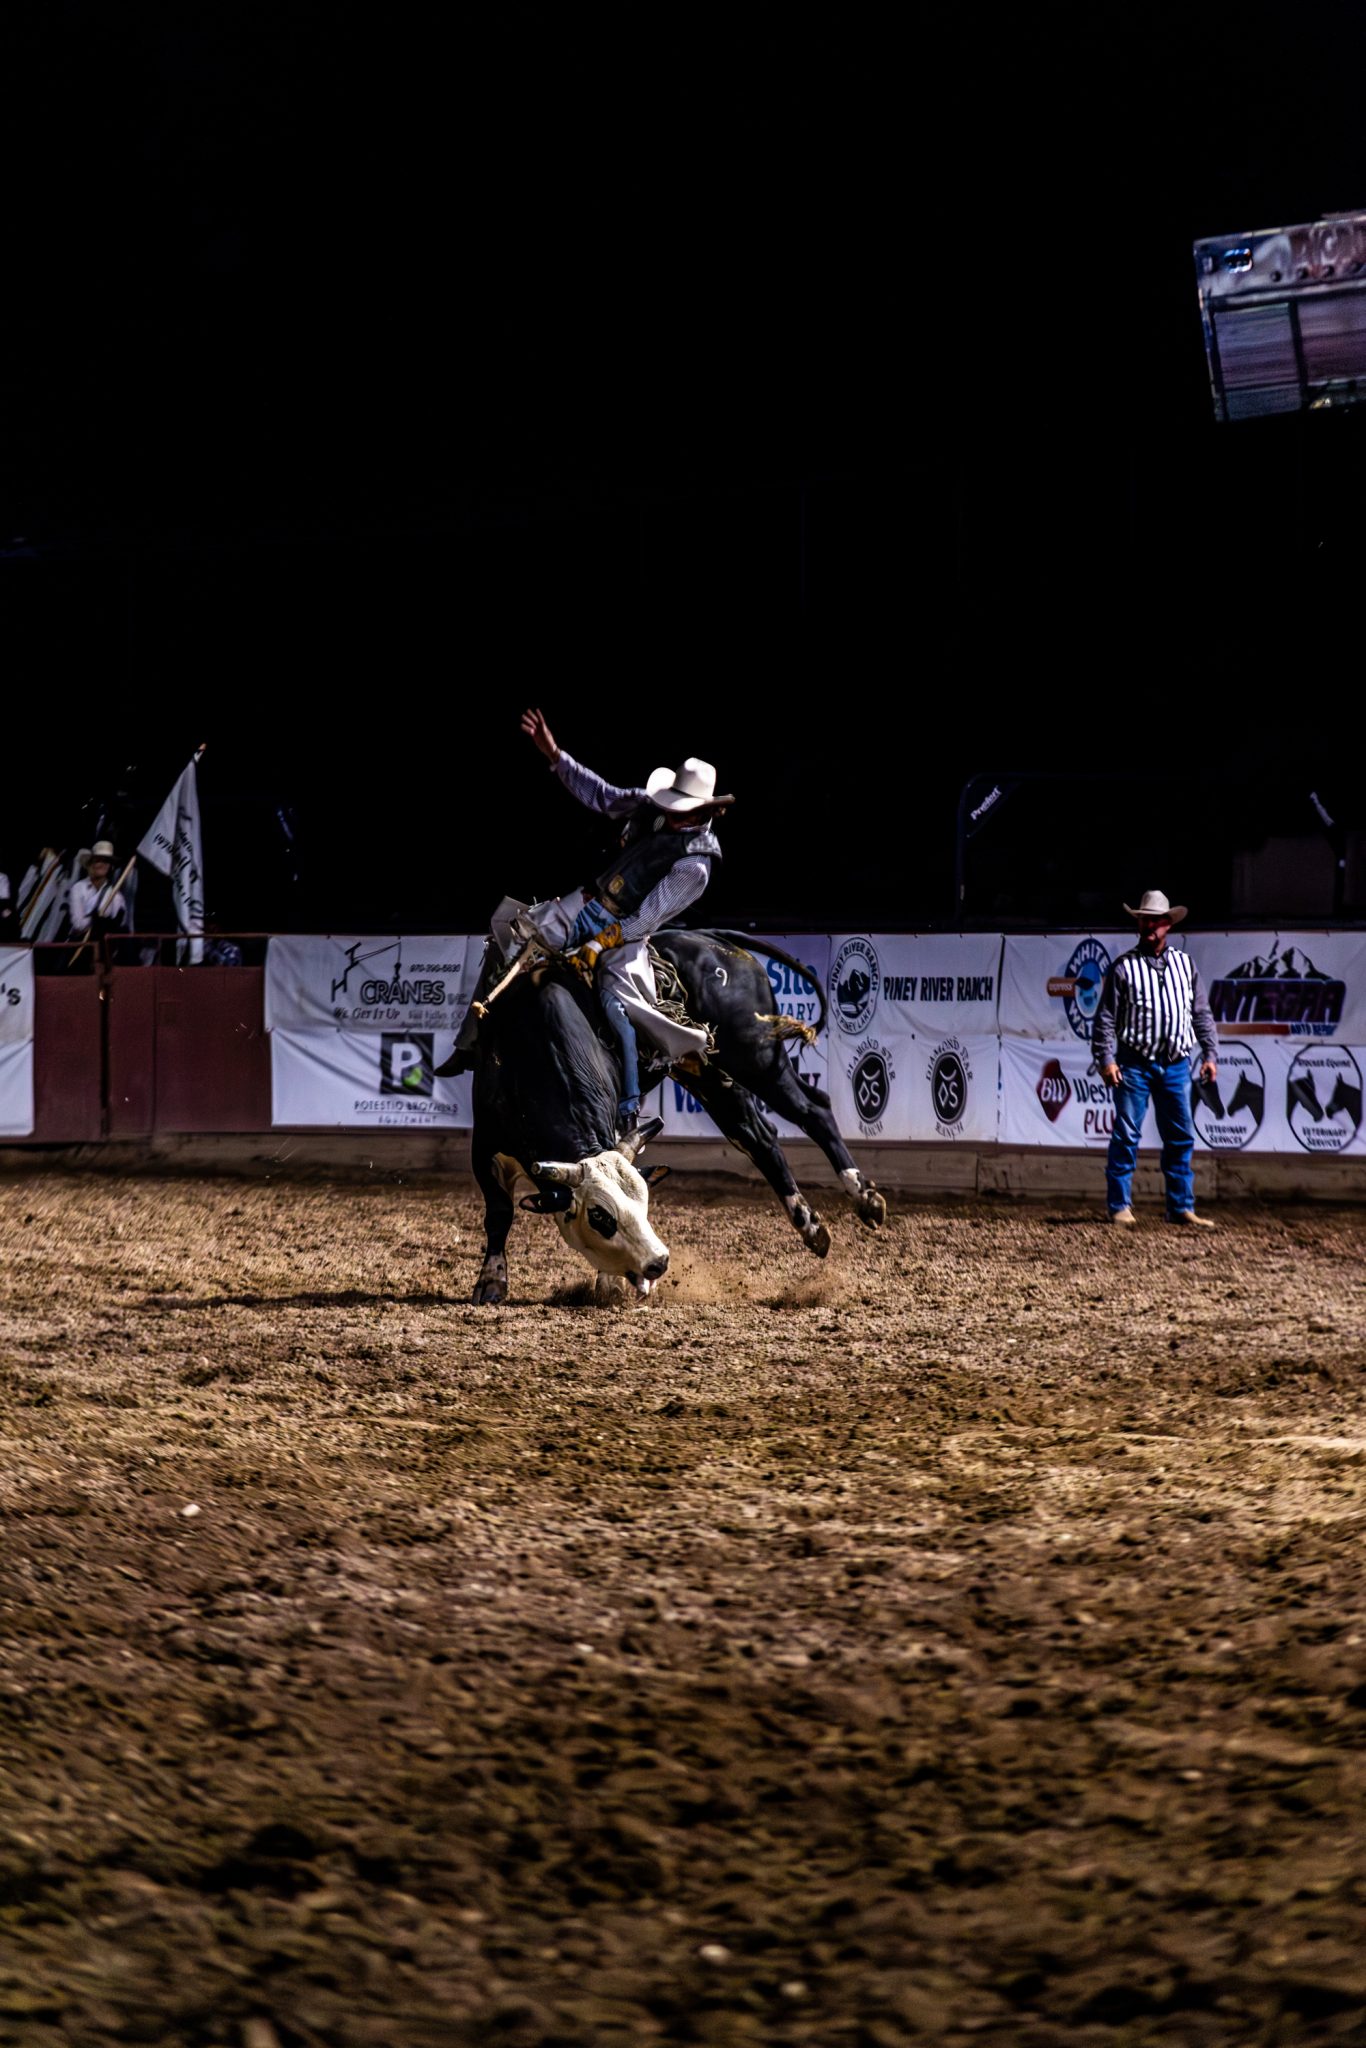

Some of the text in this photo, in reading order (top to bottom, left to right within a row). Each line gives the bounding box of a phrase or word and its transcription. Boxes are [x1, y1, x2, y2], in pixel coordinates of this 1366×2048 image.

[843, 941, 866, 957] RIVER
[1069, 943, 1110, 975] WHITE
[360, 979, 446, 1006] CRANES
[883, 976, 994, 1002] PINEY RIVER RANCH
[1068, 1000, 1094, 1038] WAT
